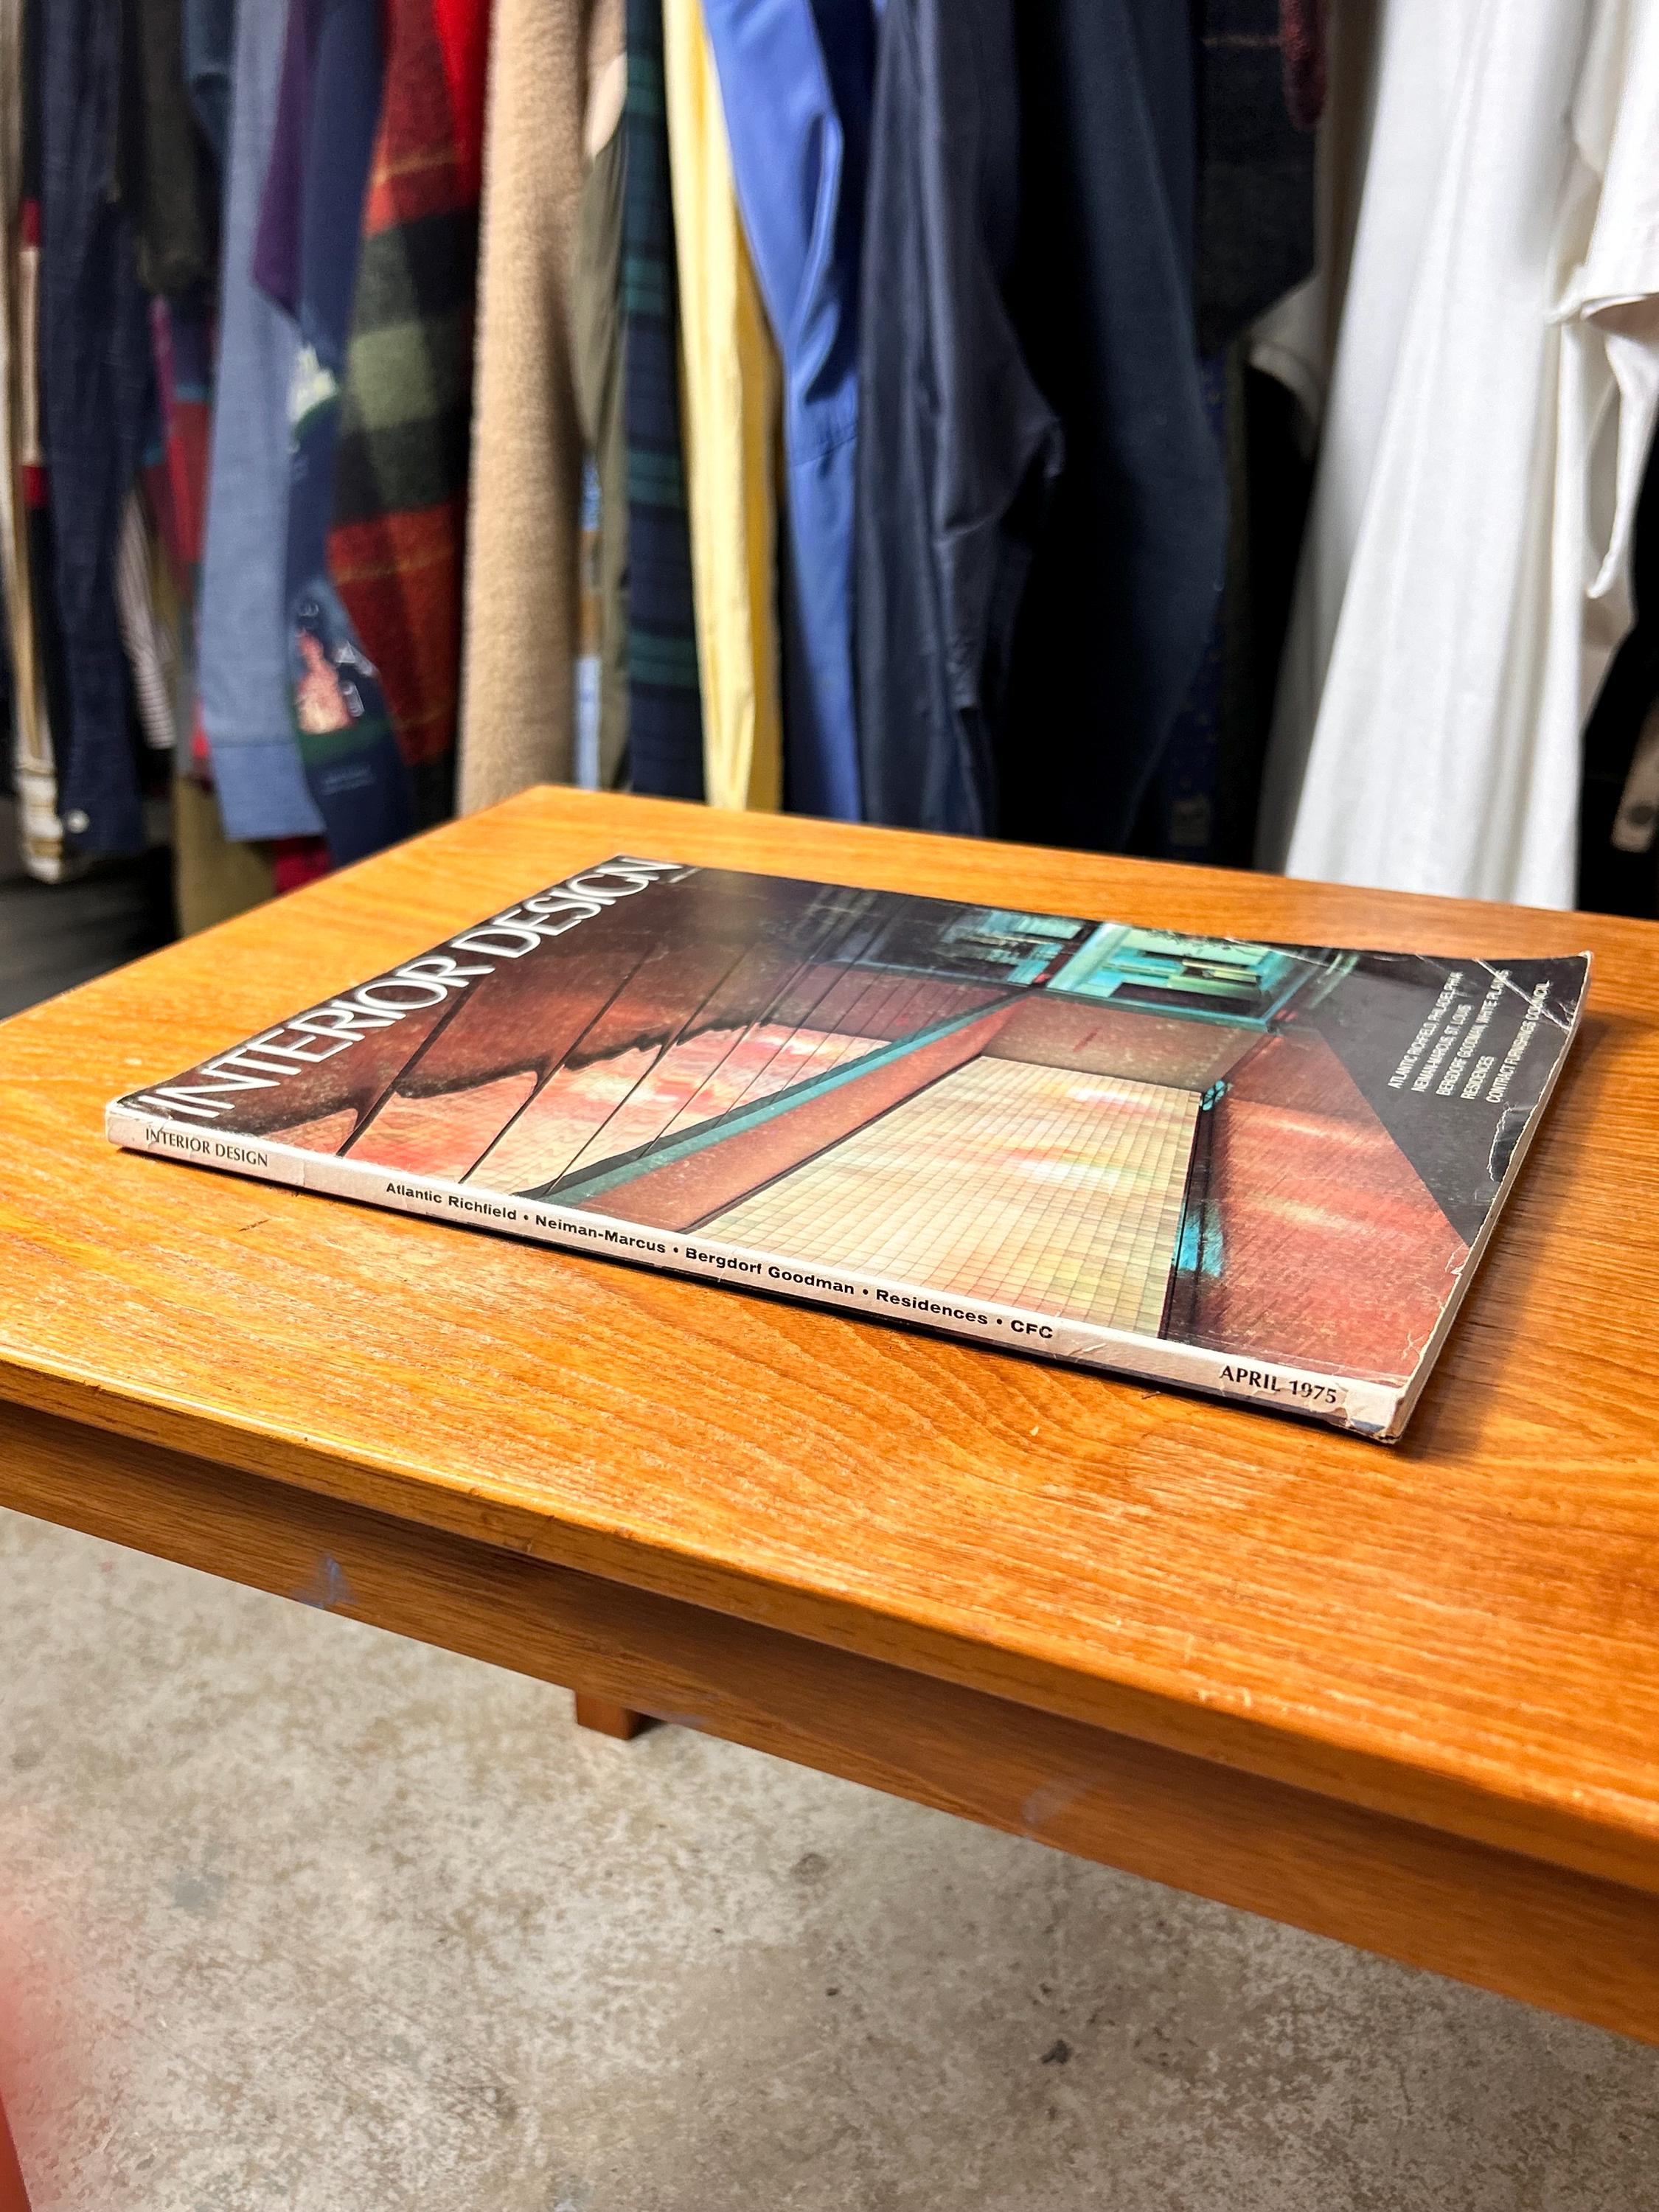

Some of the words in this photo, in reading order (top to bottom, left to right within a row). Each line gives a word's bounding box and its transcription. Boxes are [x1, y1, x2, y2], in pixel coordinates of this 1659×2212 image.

[138, 953, 495, 1118] INTERIOR
[453, 856, 684, 959] DESIGN
[1387, 1054, 1418, 1089] ATLANTIC
[1460, 1055, 1495, 1100] RESIDENCES
[1485, 1063, 1515, 1104] CONTRACT
[145, 1127, 212, 1158] INTERIOR
[214, 1140, 269, 1168] DESIGN
[386, 1181, 442, 1206] Atlantic
[448, 1193, 518, 1222] Richfield
[535, 1213, 667, 1255] Neiman-Marcus
[686, 1247, 763, 1276] Bergdorf
[768, 1263, 855, 1295] Goodman
[875, 1287, 989, 1326] Residences
[1010, 1318, 1054, 1340] CFC
[1220, 1365, 1281, 1392] APRIL
[1288, 1380, 1338, 1405] 1975
